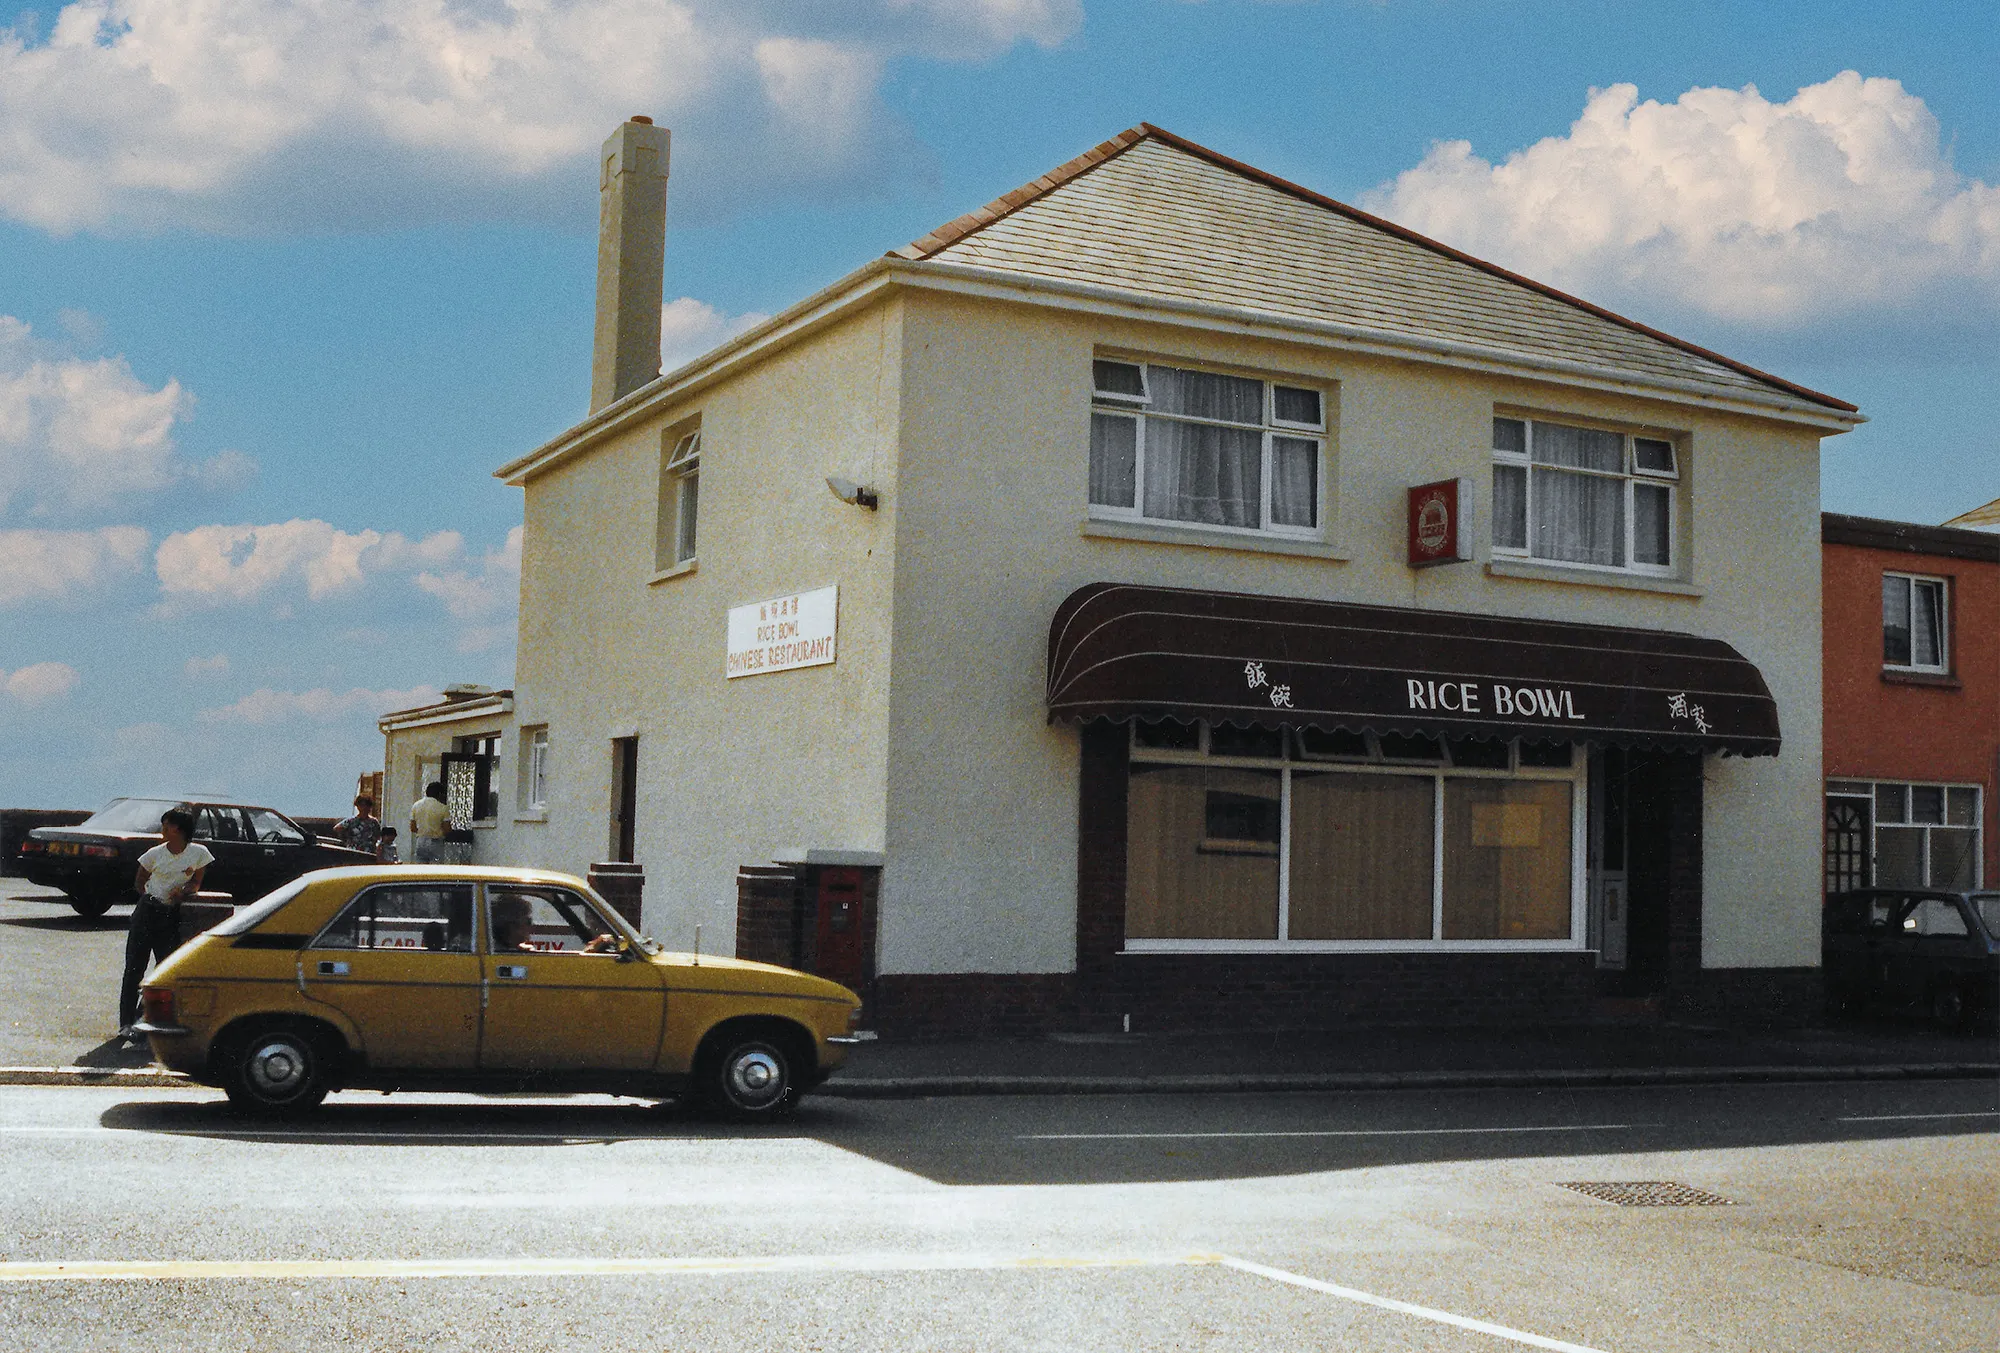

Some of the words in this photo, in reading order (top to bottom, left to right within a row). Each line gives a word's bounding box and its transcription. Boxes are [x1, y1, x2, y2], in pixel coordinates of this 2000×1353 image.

[757, 624, 775, 642] RICE
[778, 620, 800, 640] BOWL
[728, 648, 764, 673] CHINESE
[768, 636, 832, 667] RESTAURANT
[1407, 679, 1481, 713] RICE
[1493, 684, 1586, 720] BOWL
